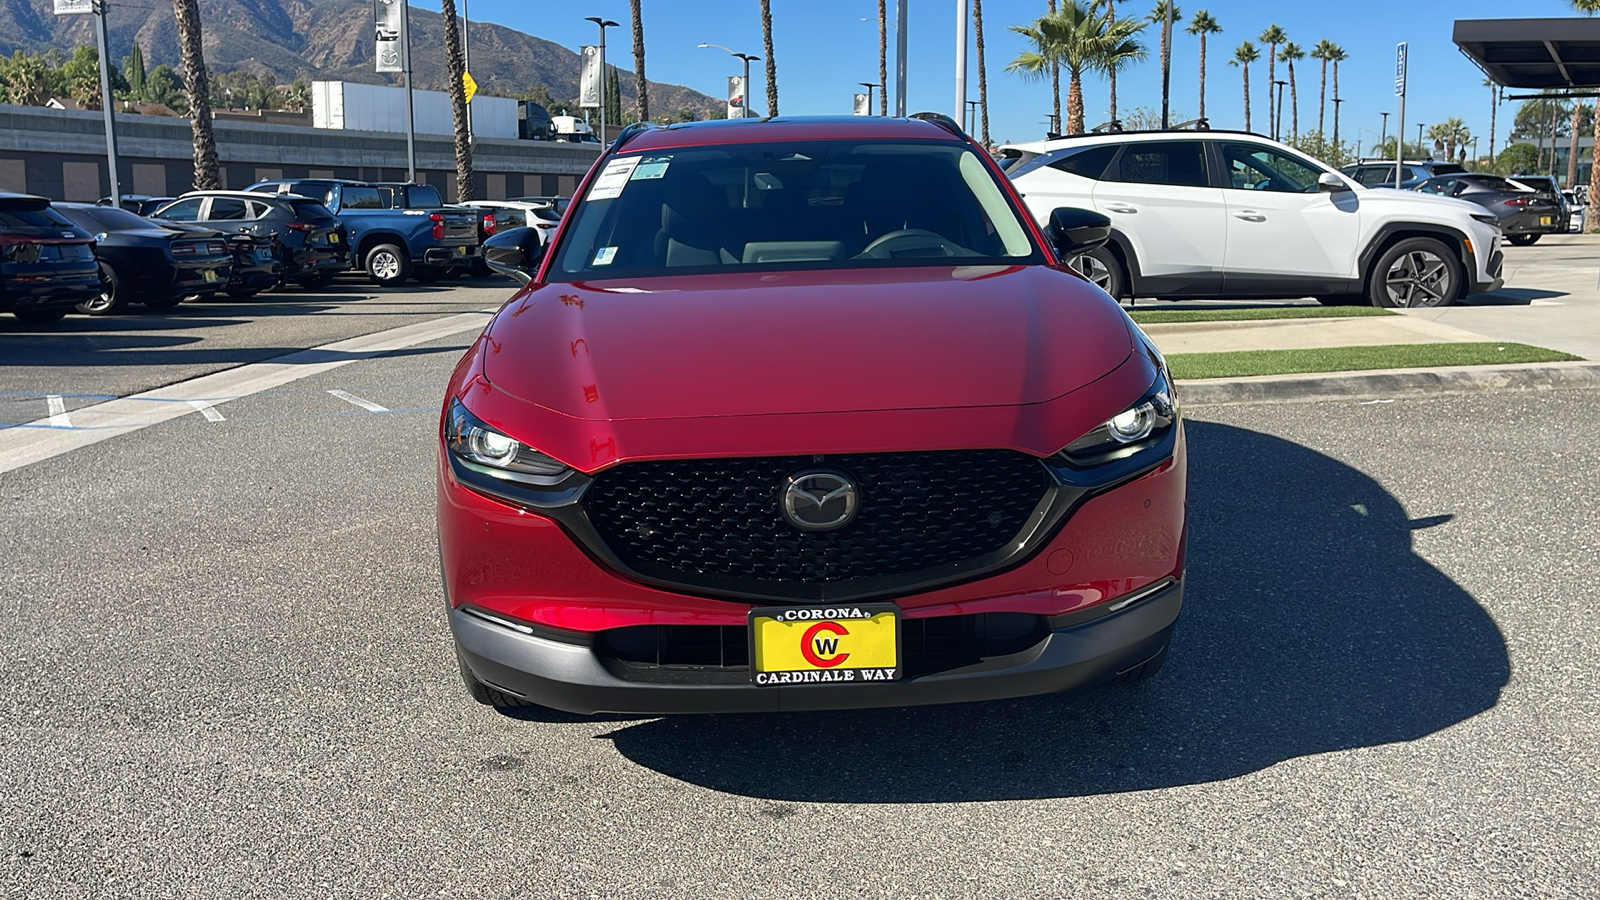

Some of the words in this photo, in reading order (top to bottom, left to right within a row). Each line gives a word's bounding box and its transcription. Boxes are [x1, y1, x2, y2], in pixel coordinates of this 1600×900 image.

[784, 607, 863, 620] CORONA
[756, 671, 855, 685] CARDINALE
[861, 668, 896, 681] WAY
